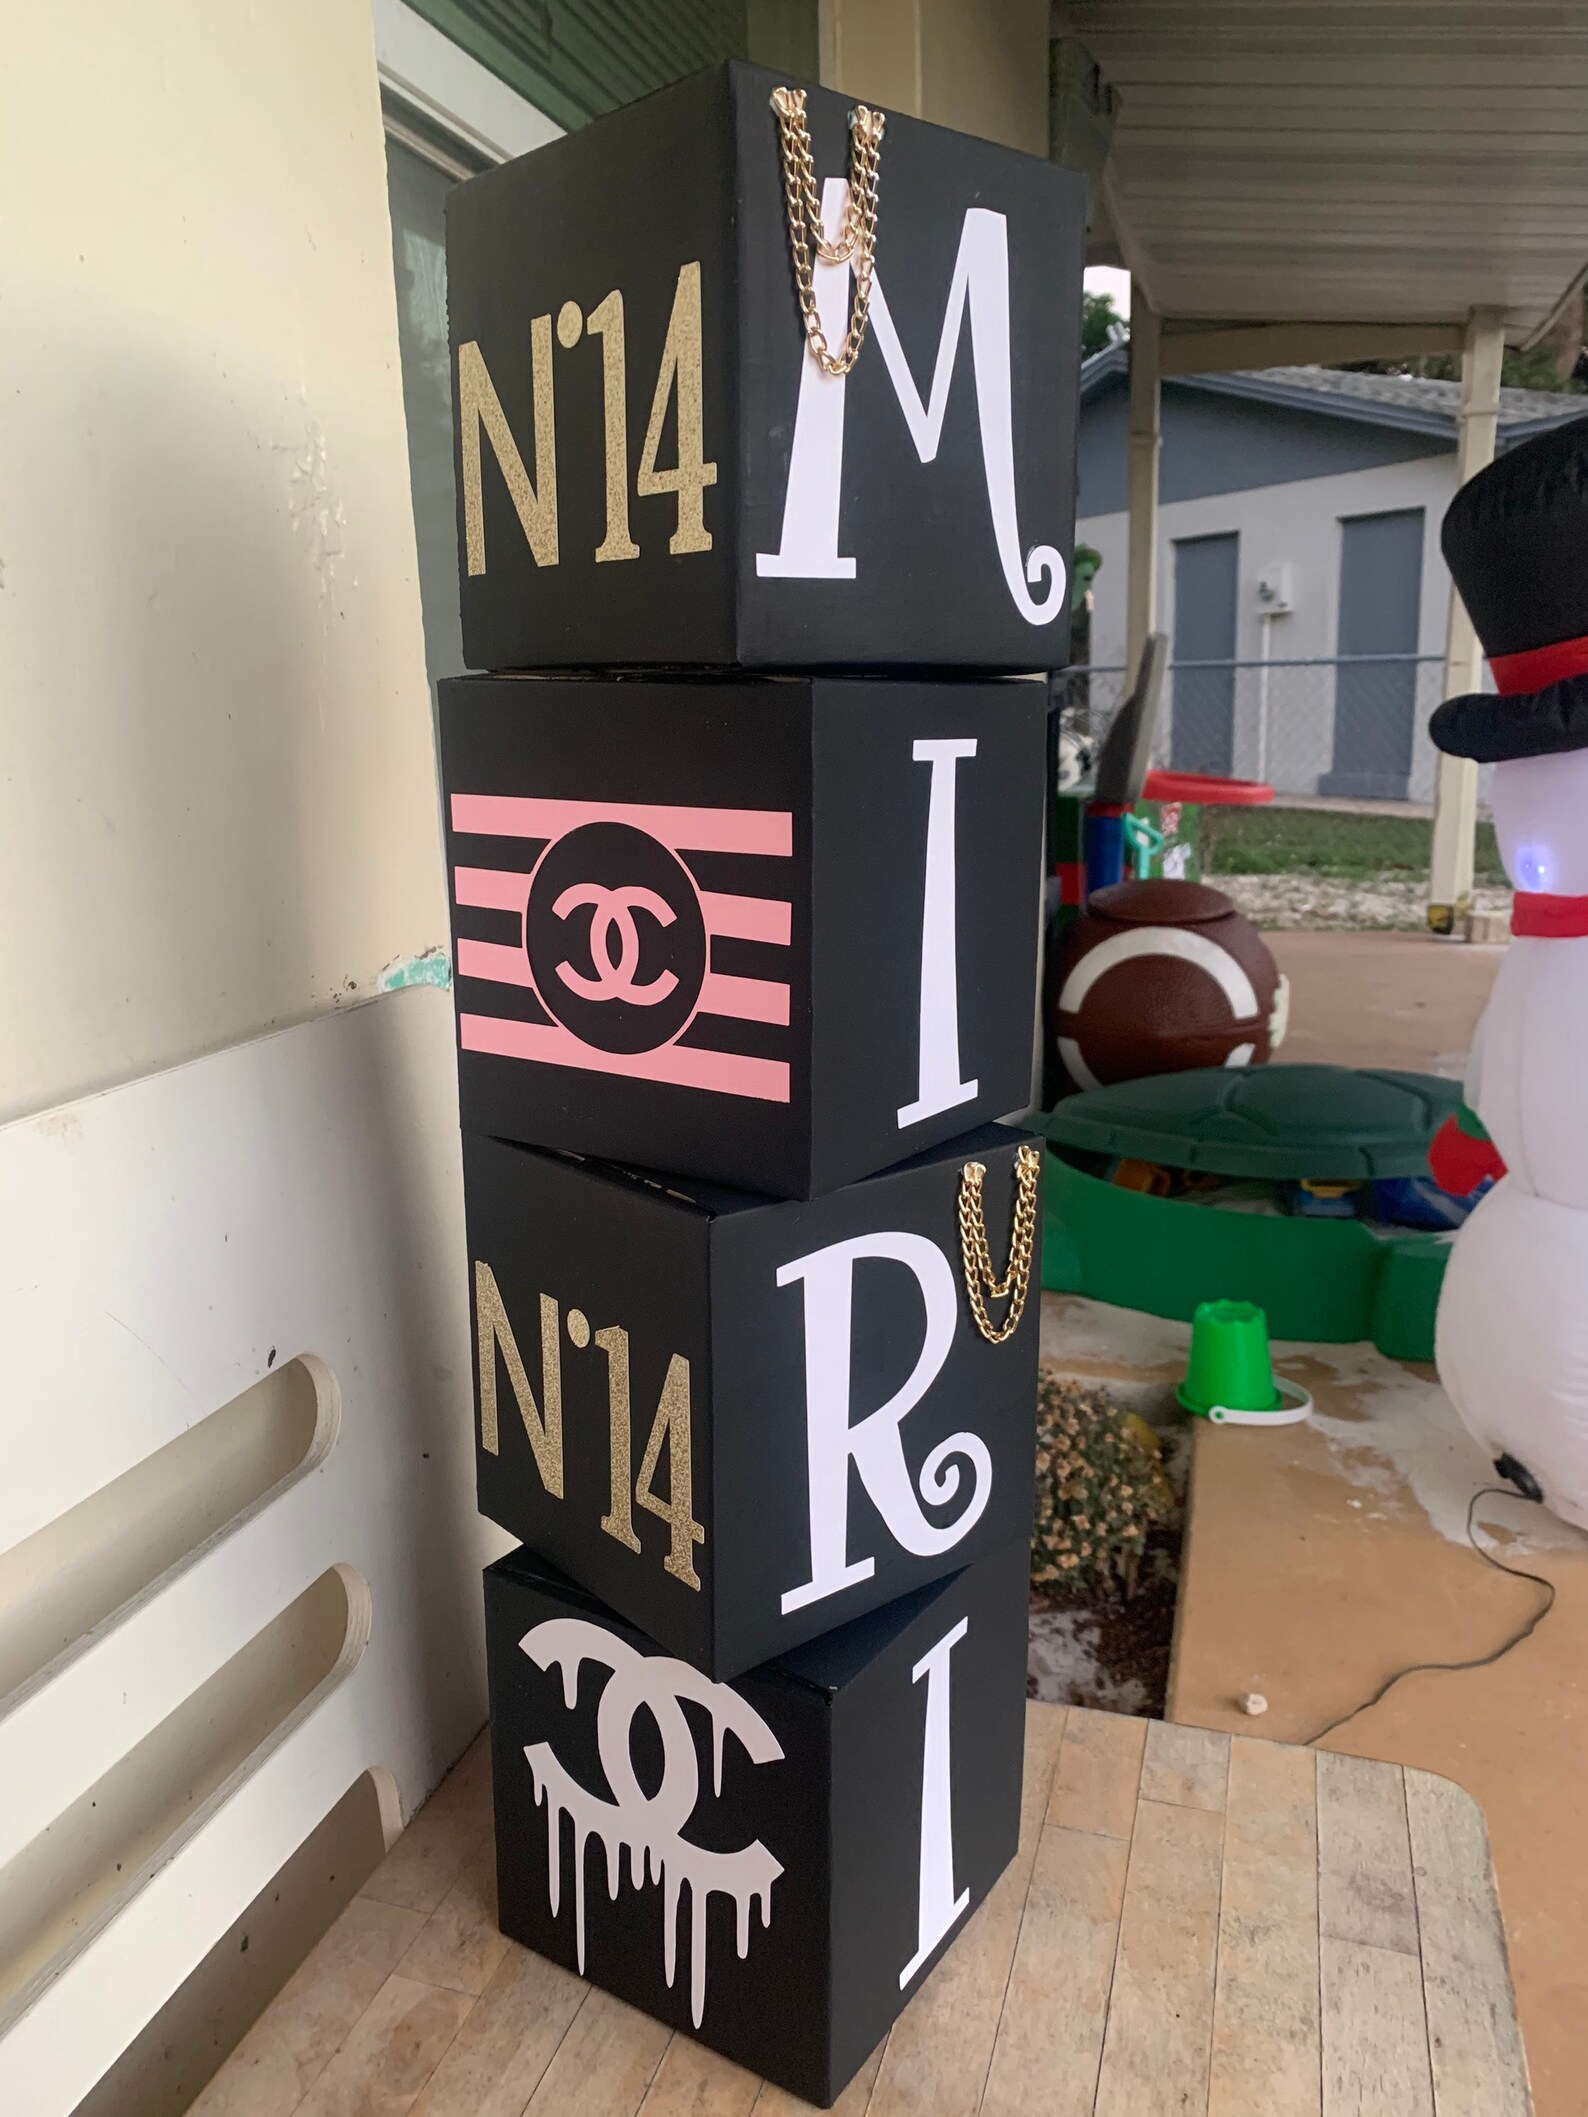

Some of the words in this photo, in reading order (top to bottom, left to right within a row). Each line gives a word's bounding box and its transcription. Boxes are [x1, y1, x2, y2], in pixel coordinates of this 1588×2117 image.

[756, 177, 1065, 625] M
[898, 739, 978, 1129] I
[776, 1232, 992, 1615] R
[900, 1616, 969, 1990] I
